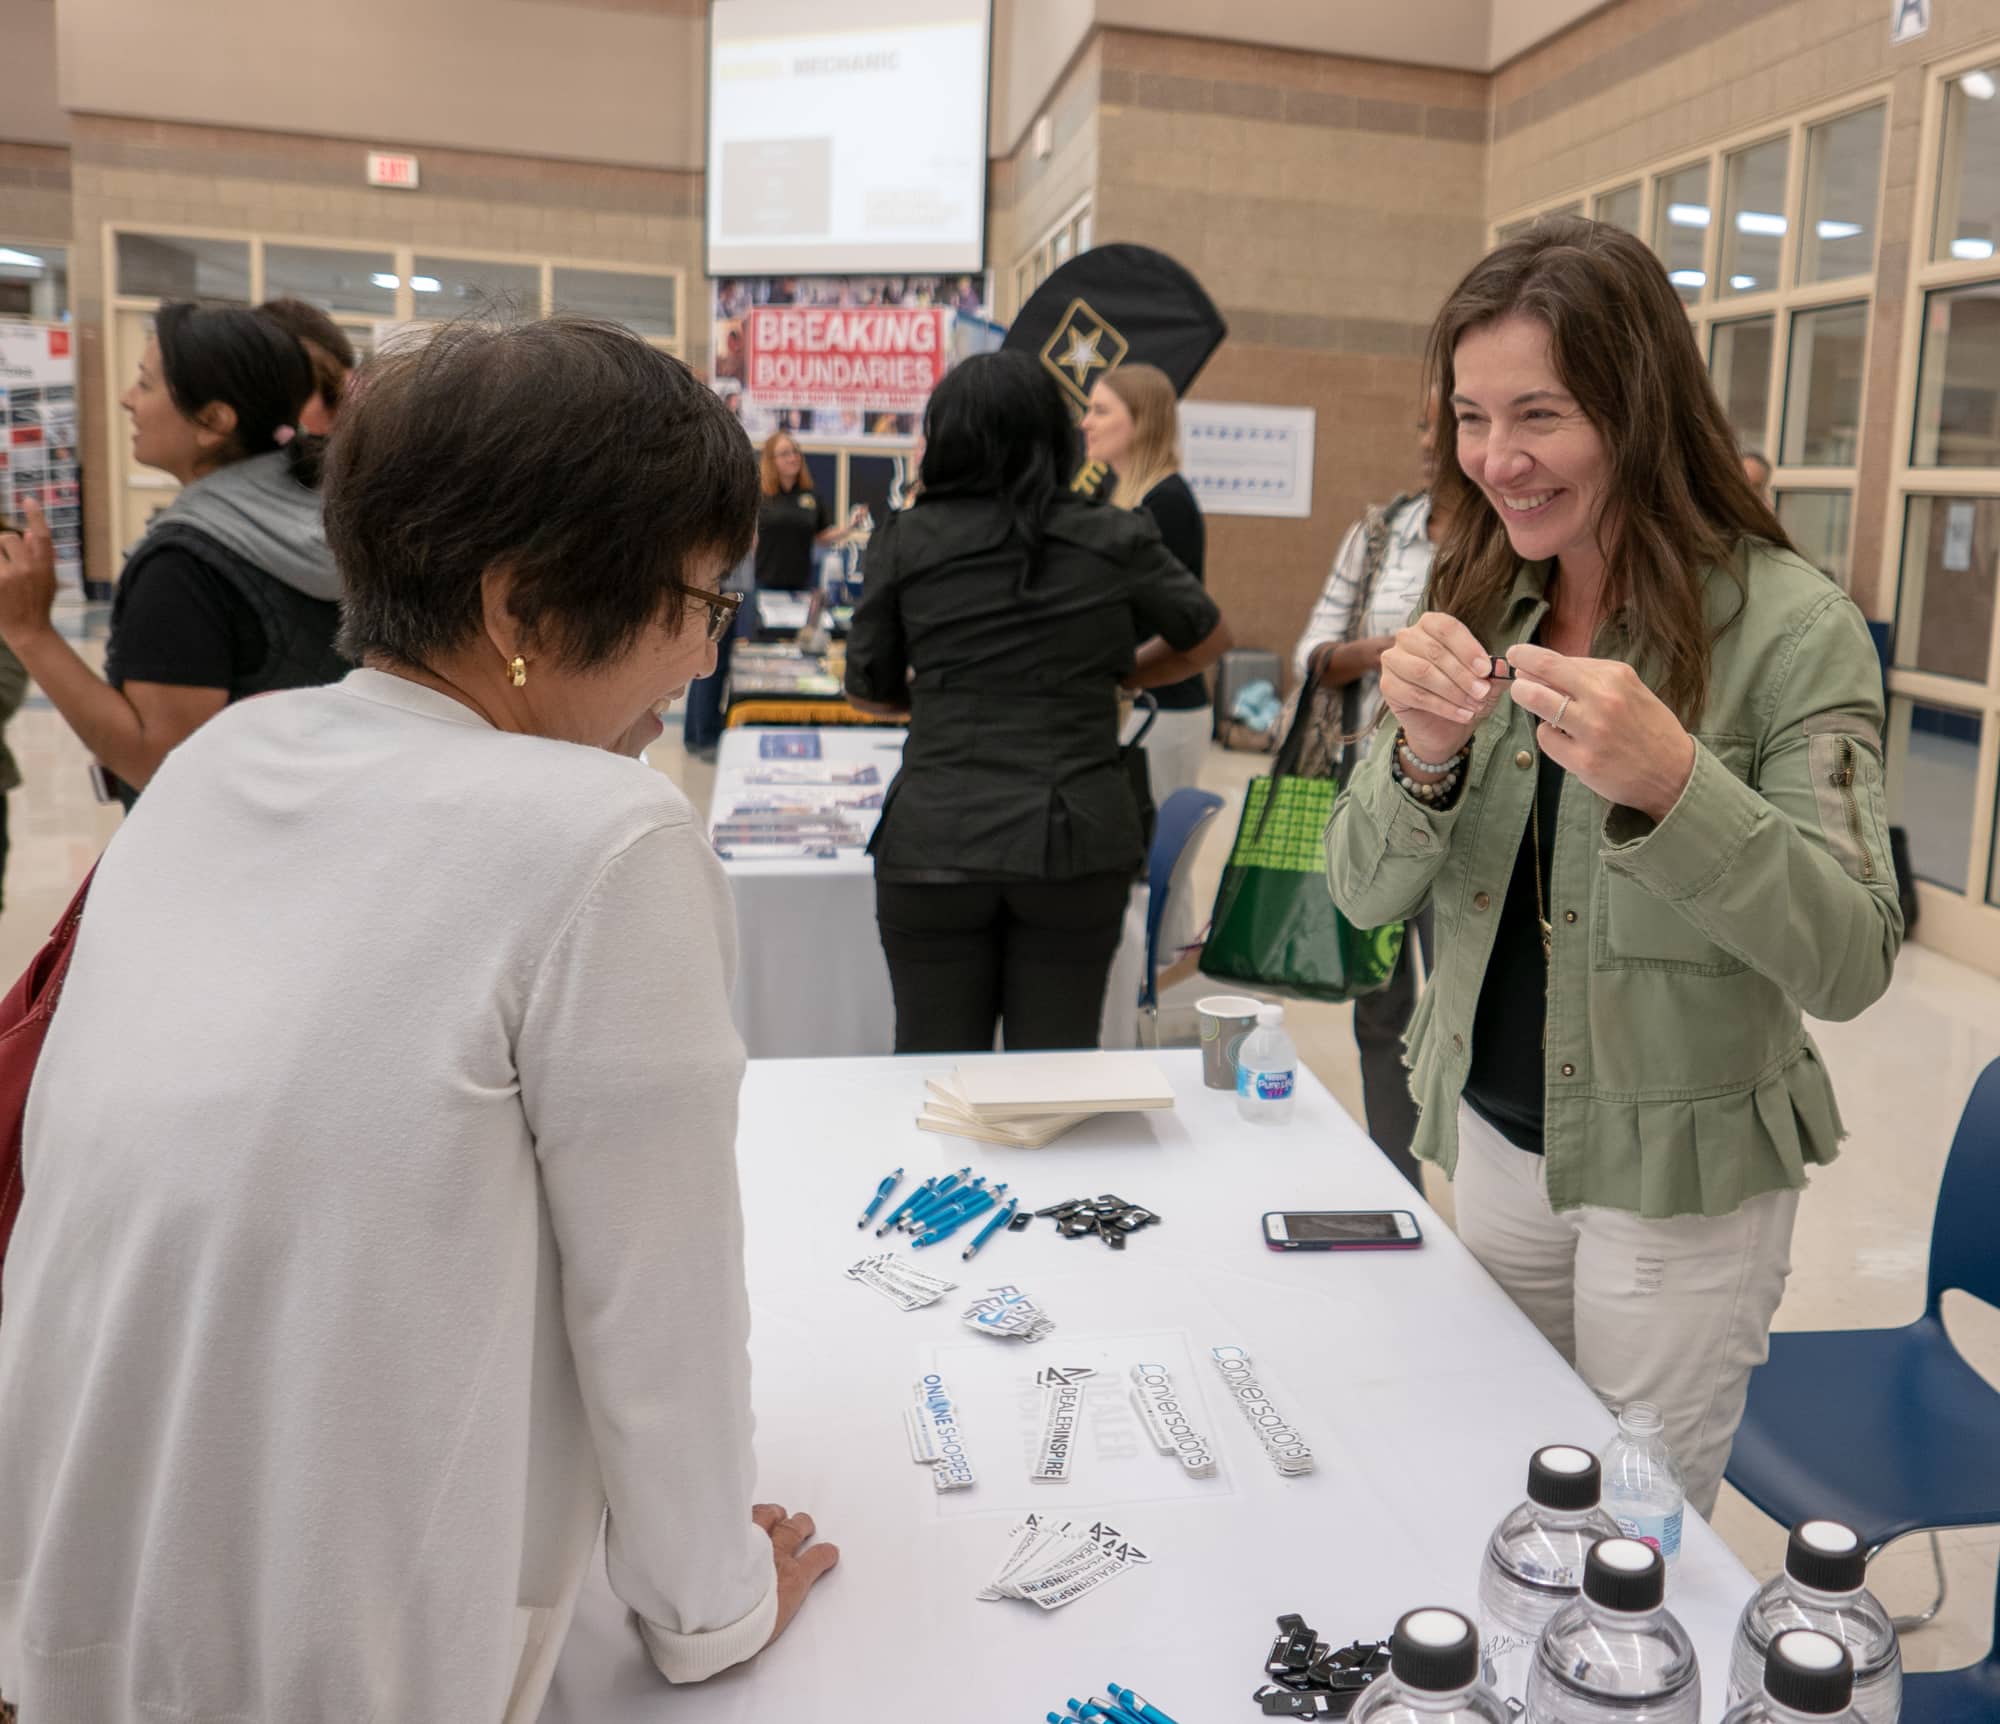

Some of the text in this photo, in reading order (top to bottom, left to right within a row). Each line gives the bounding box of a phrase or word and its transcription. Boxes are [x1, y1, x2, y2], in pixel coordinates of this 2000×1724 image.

[793, 49, 902, 76] MECHANIC
[757, 310, 936, 352] BREAKING
[757, 351, 934, 389] BOUNDARIES
[923, 1374, 954, 1426] ONLINE
[1138, 1363, 1211, 1466] Conversations
[1213, 1345, 1311, 1458] Conversations
[937, 1426, 973, 1482] SHOPPER
[1044, 1387, 1078, 1476] DEALERINSPIRE
[1040, 1561, 1123, 1607] DEALERINSPIRE
